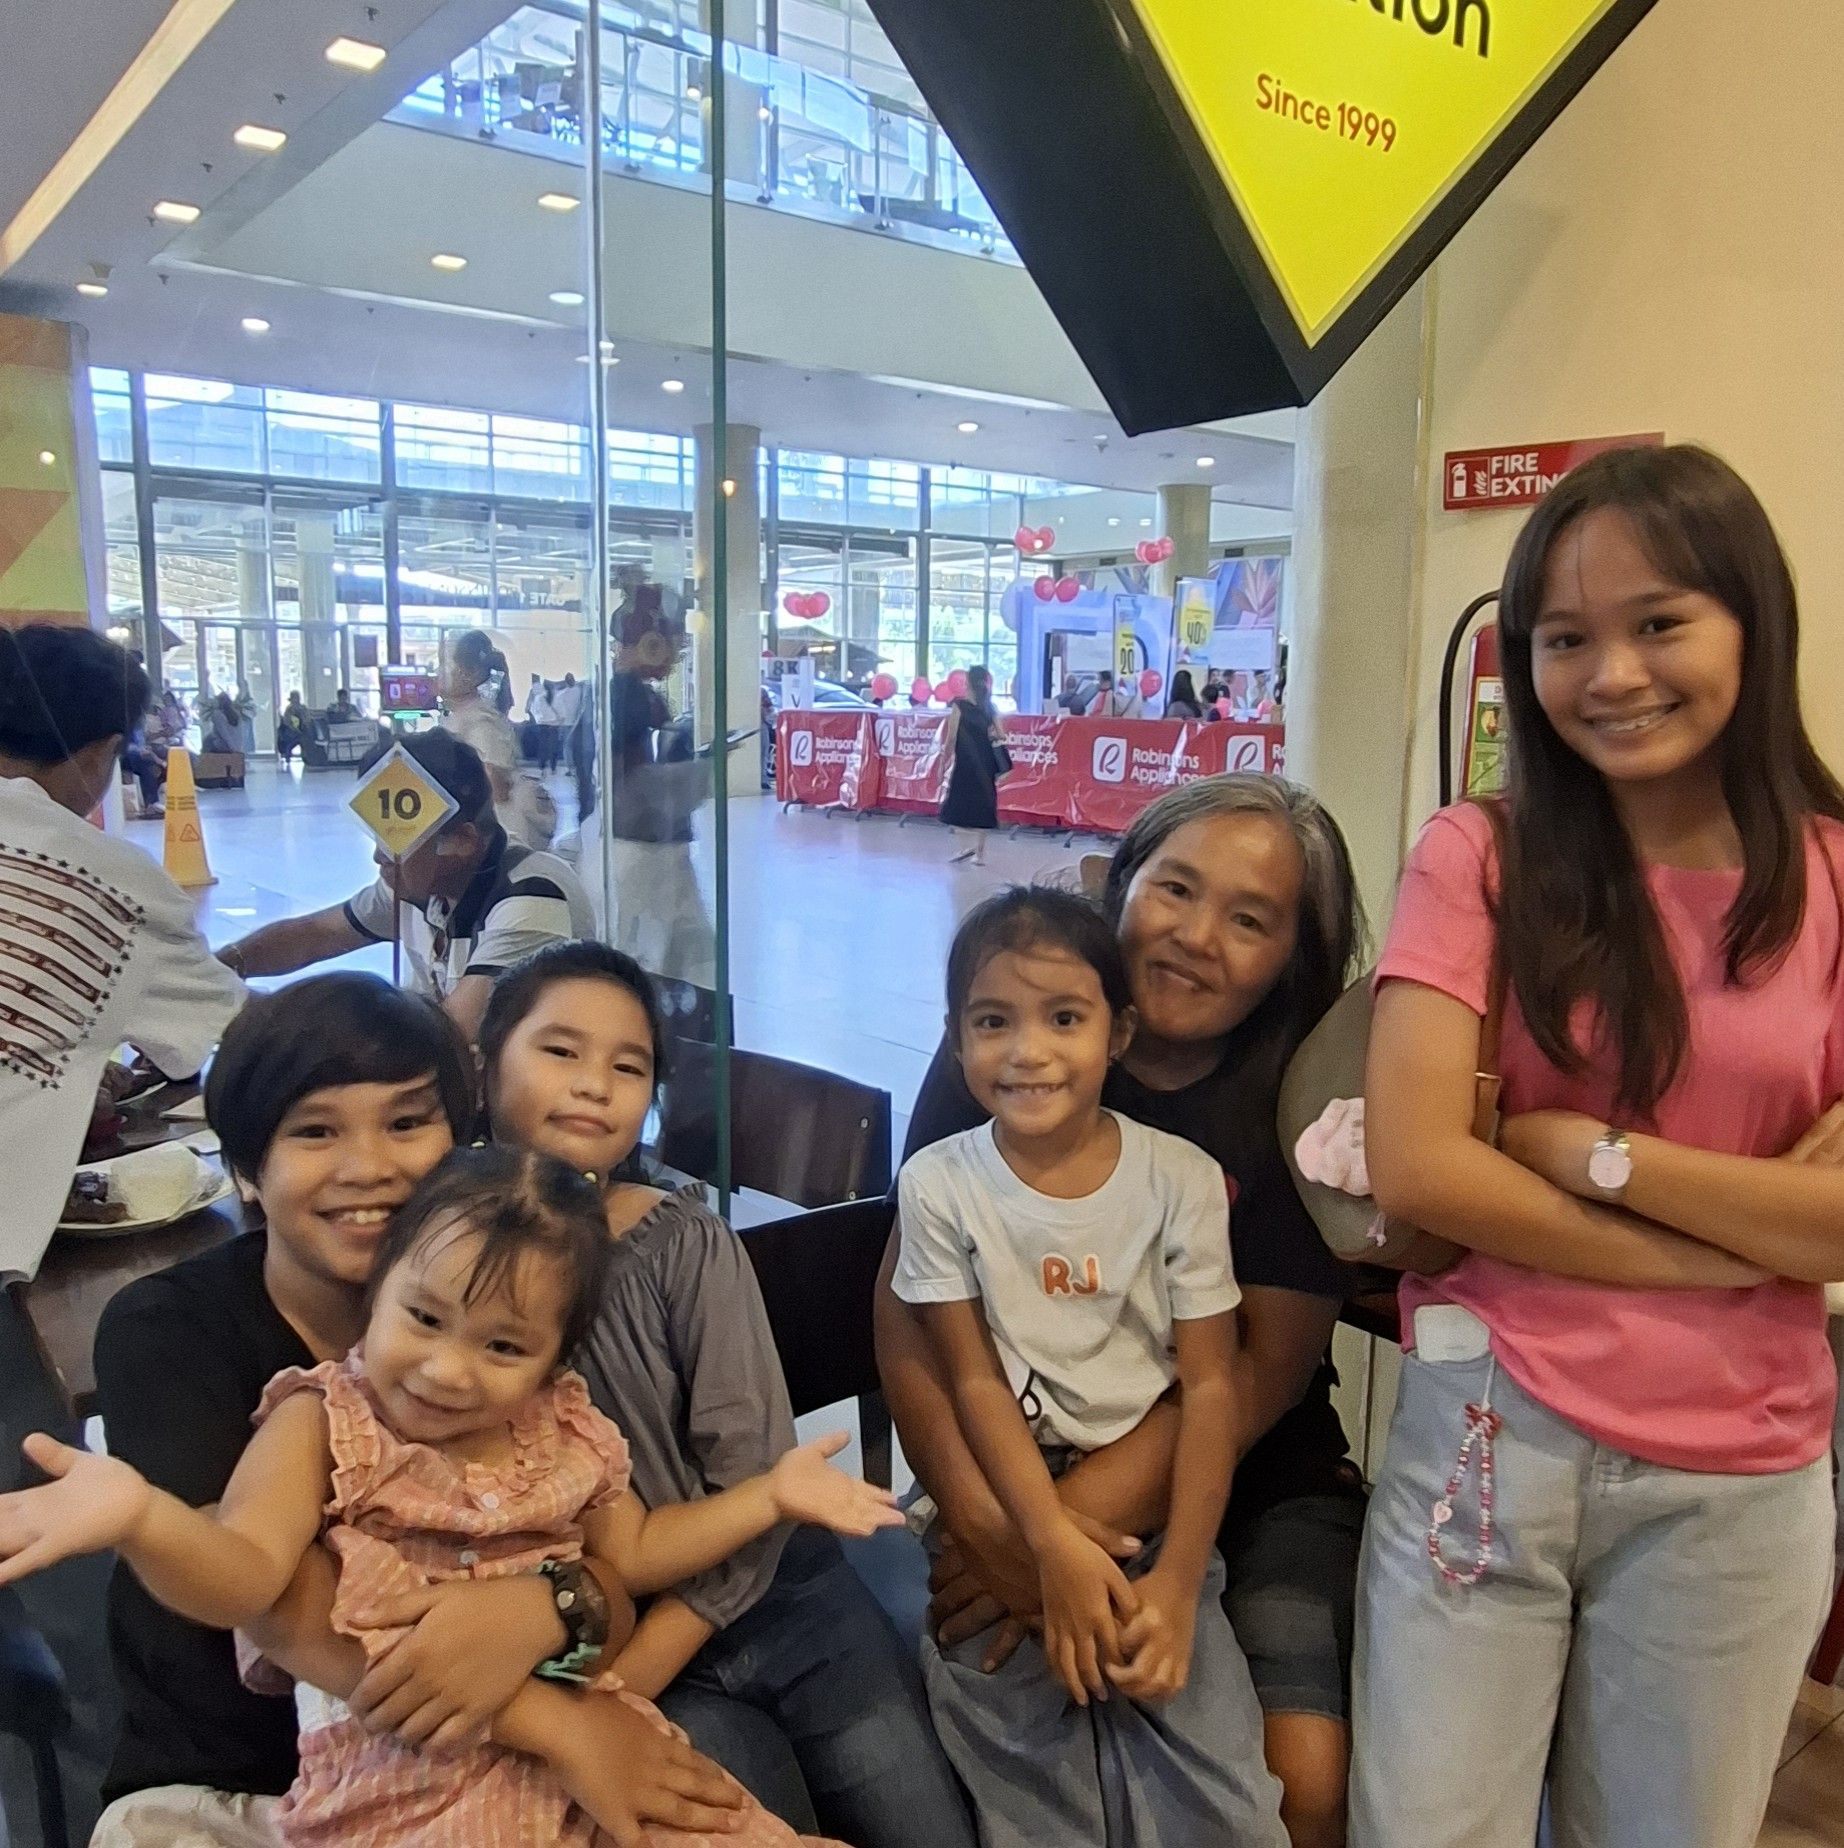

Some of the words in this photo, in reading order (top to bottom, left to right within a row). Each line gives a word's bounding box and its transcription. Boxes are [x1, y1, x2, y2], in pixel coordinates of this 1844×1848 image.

[1255, 73, 1331, 130] Since
[1337, 102, 1397, 152] 1999
[1491, 452, 1539, 476] FIRE
[378, 788, 422, 820] 10
[1042, 1254, 1099, 1296] RJ
